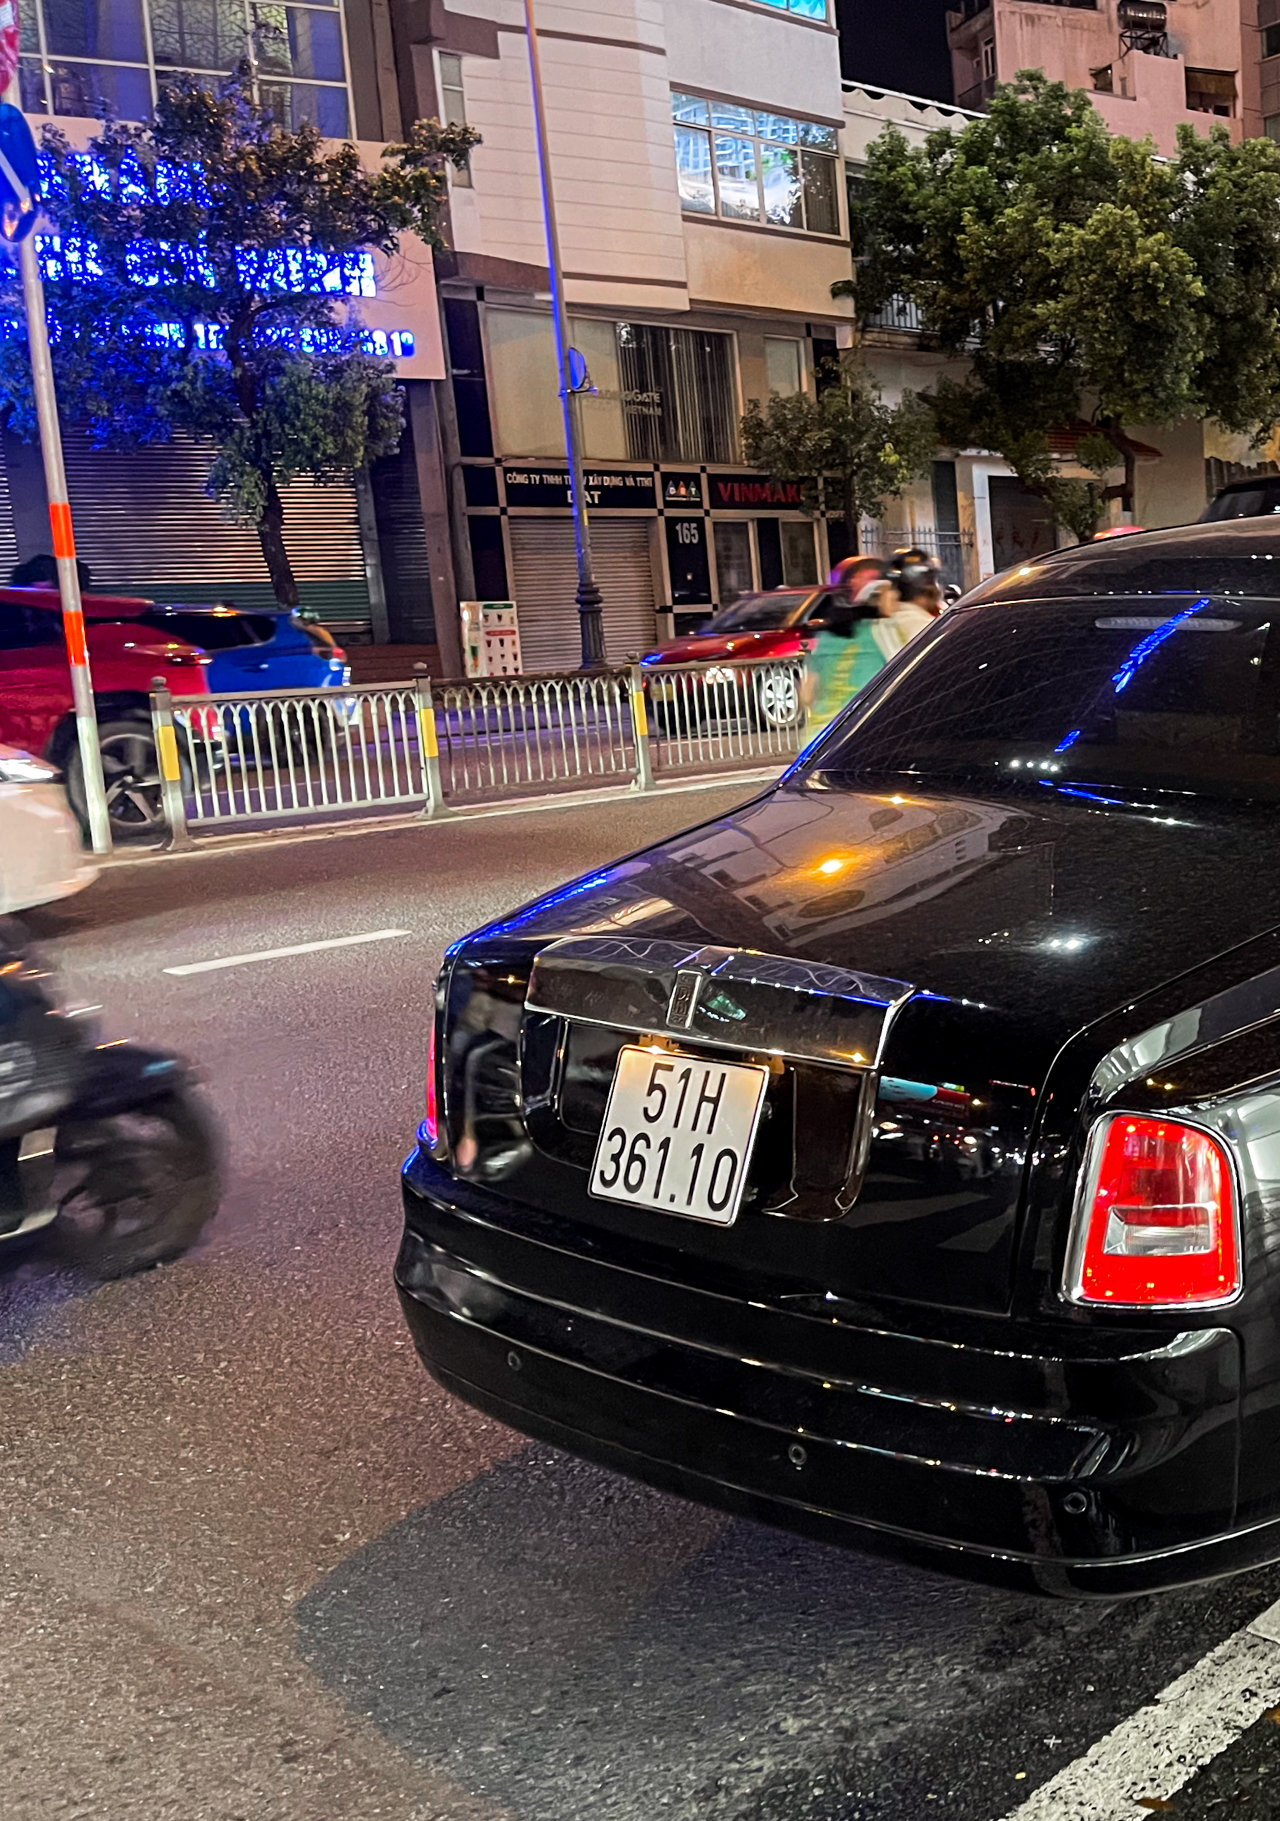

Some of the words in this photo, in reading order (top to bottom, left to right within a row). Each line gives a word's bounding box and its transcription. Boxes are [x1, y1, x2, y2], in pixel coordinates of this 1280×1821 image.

[530, 475, 540, 484] TY
[676, 522, 699, 544] 165
[643, 1062, 727, 1135] 51H
[599, 1127, 738, 1212] 361.10
